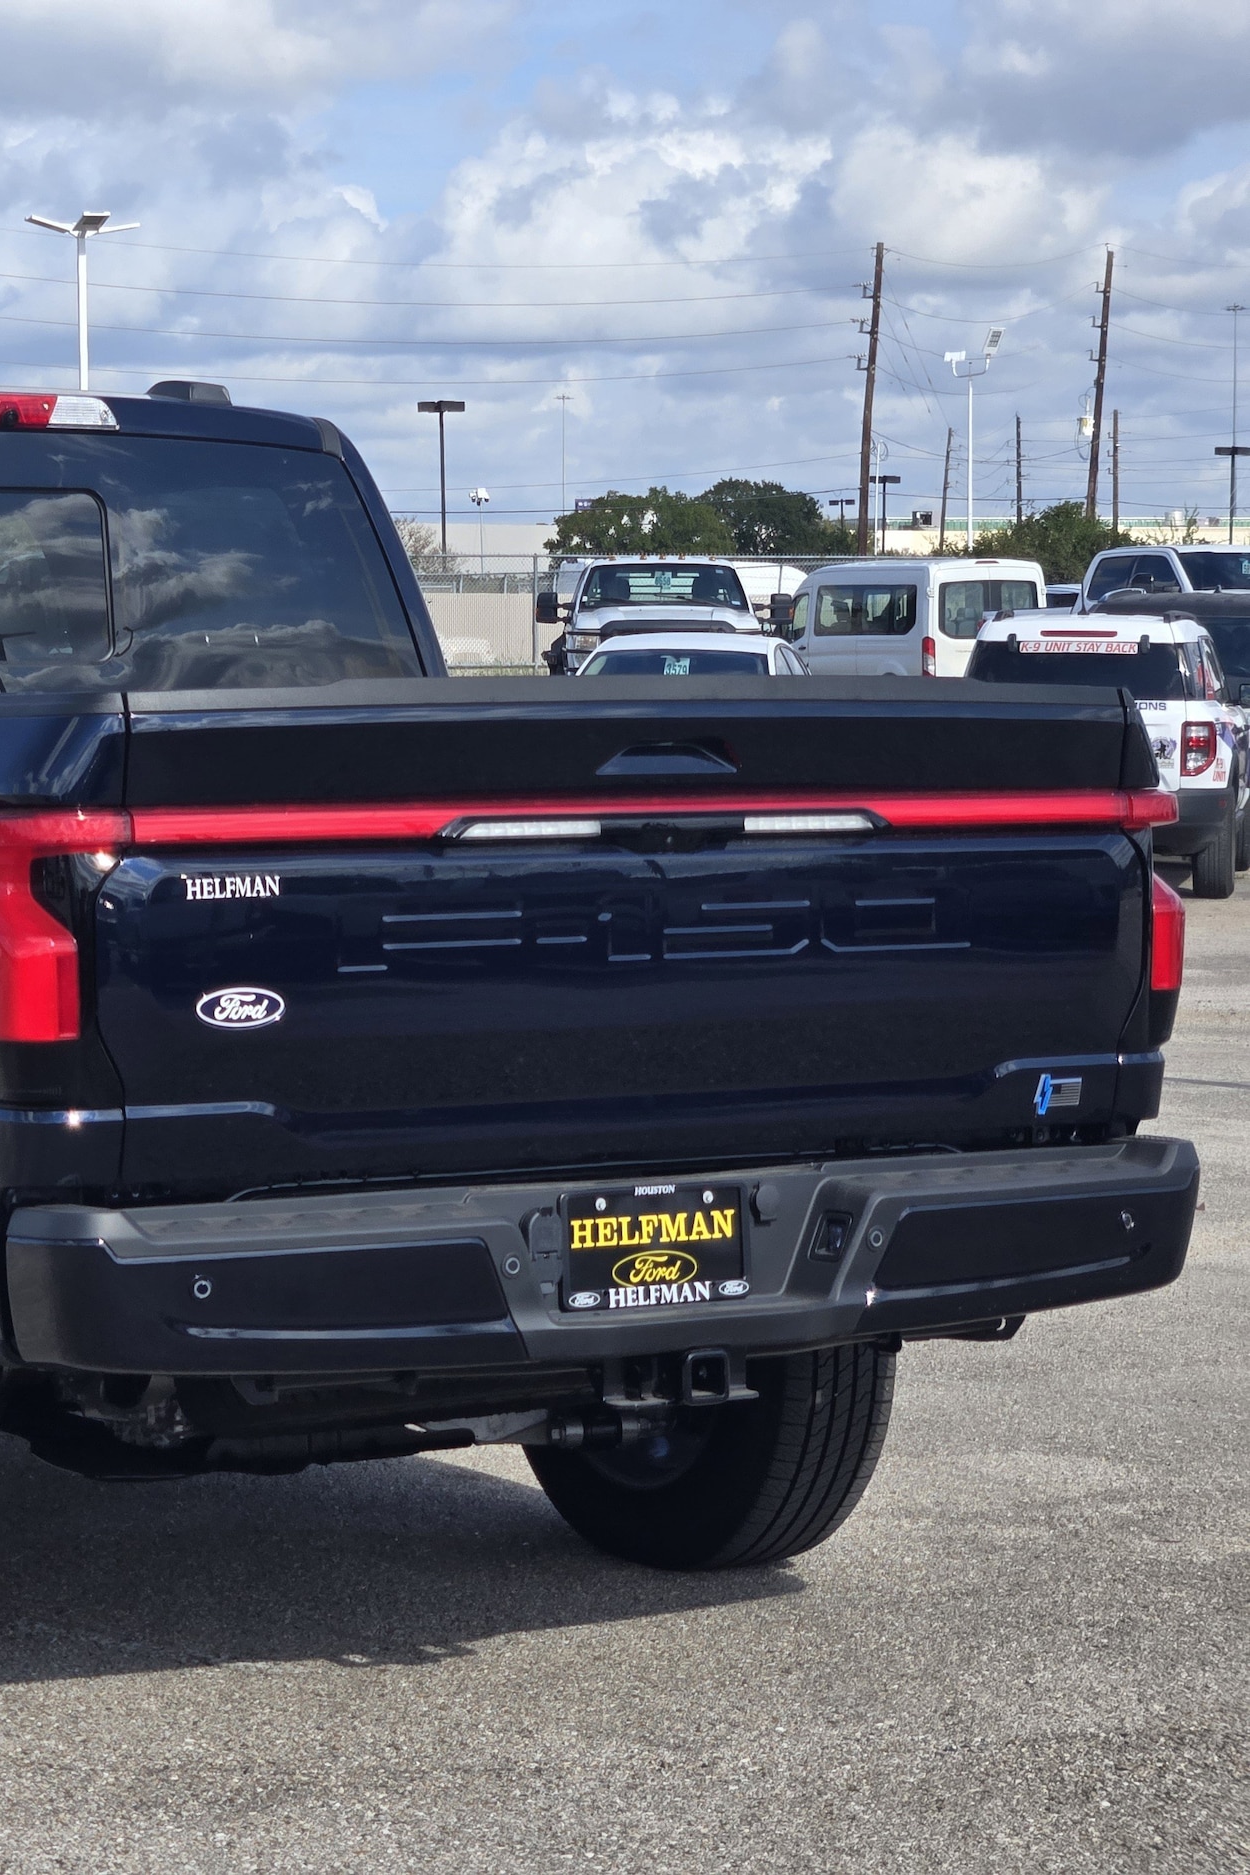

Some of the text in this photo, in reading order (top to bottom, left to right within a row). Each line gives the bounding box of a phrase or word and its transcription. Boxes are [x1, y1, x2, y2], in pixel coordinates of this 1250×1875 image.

[1020, 642, 1136, 653] K-9 UNIT STAY BACK
[185, 875, 281, 900] HELFMAN
[214, 993, 269, 1021] Ford
[634, 1184, 676, 1196] HOUSTON
[570, 1208, 735, 1249] HELFMAN
[629, 1255, 682, 1284] Ford
[574, 1295, 595, 1306] Ford
[608, 1280, 713, 1309] HELFMAN
[724, 1283, 744, 1294] Ford
